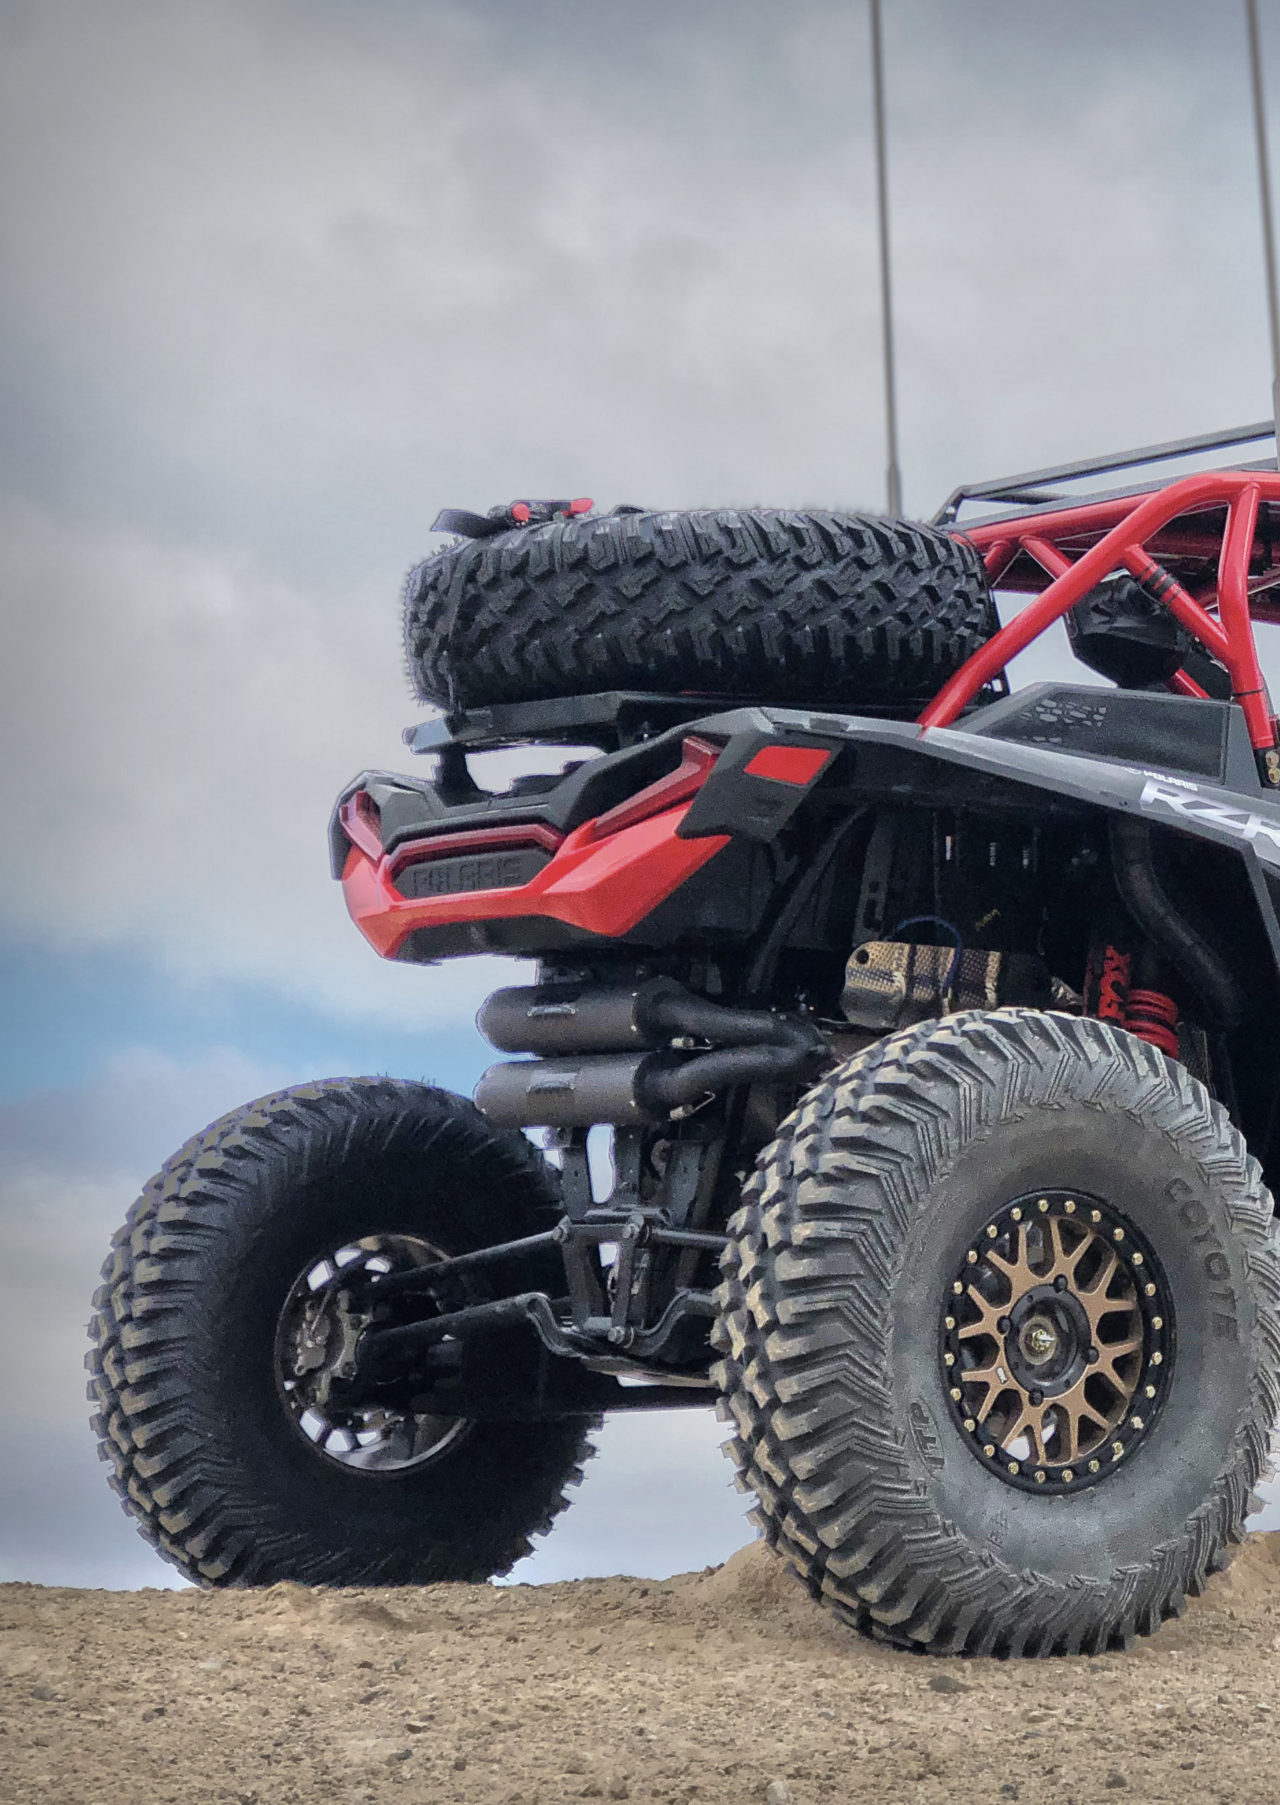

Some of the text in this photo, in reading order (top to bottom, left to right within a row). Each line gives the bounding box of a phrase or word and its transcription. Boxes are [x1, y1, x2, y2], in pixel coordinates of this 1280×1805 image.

[1143, 770, 1199, 792] POLARIS
[1162, 1177, 1240, 1344] COYOTE
[910, 1401, 946, 1470] ITP
